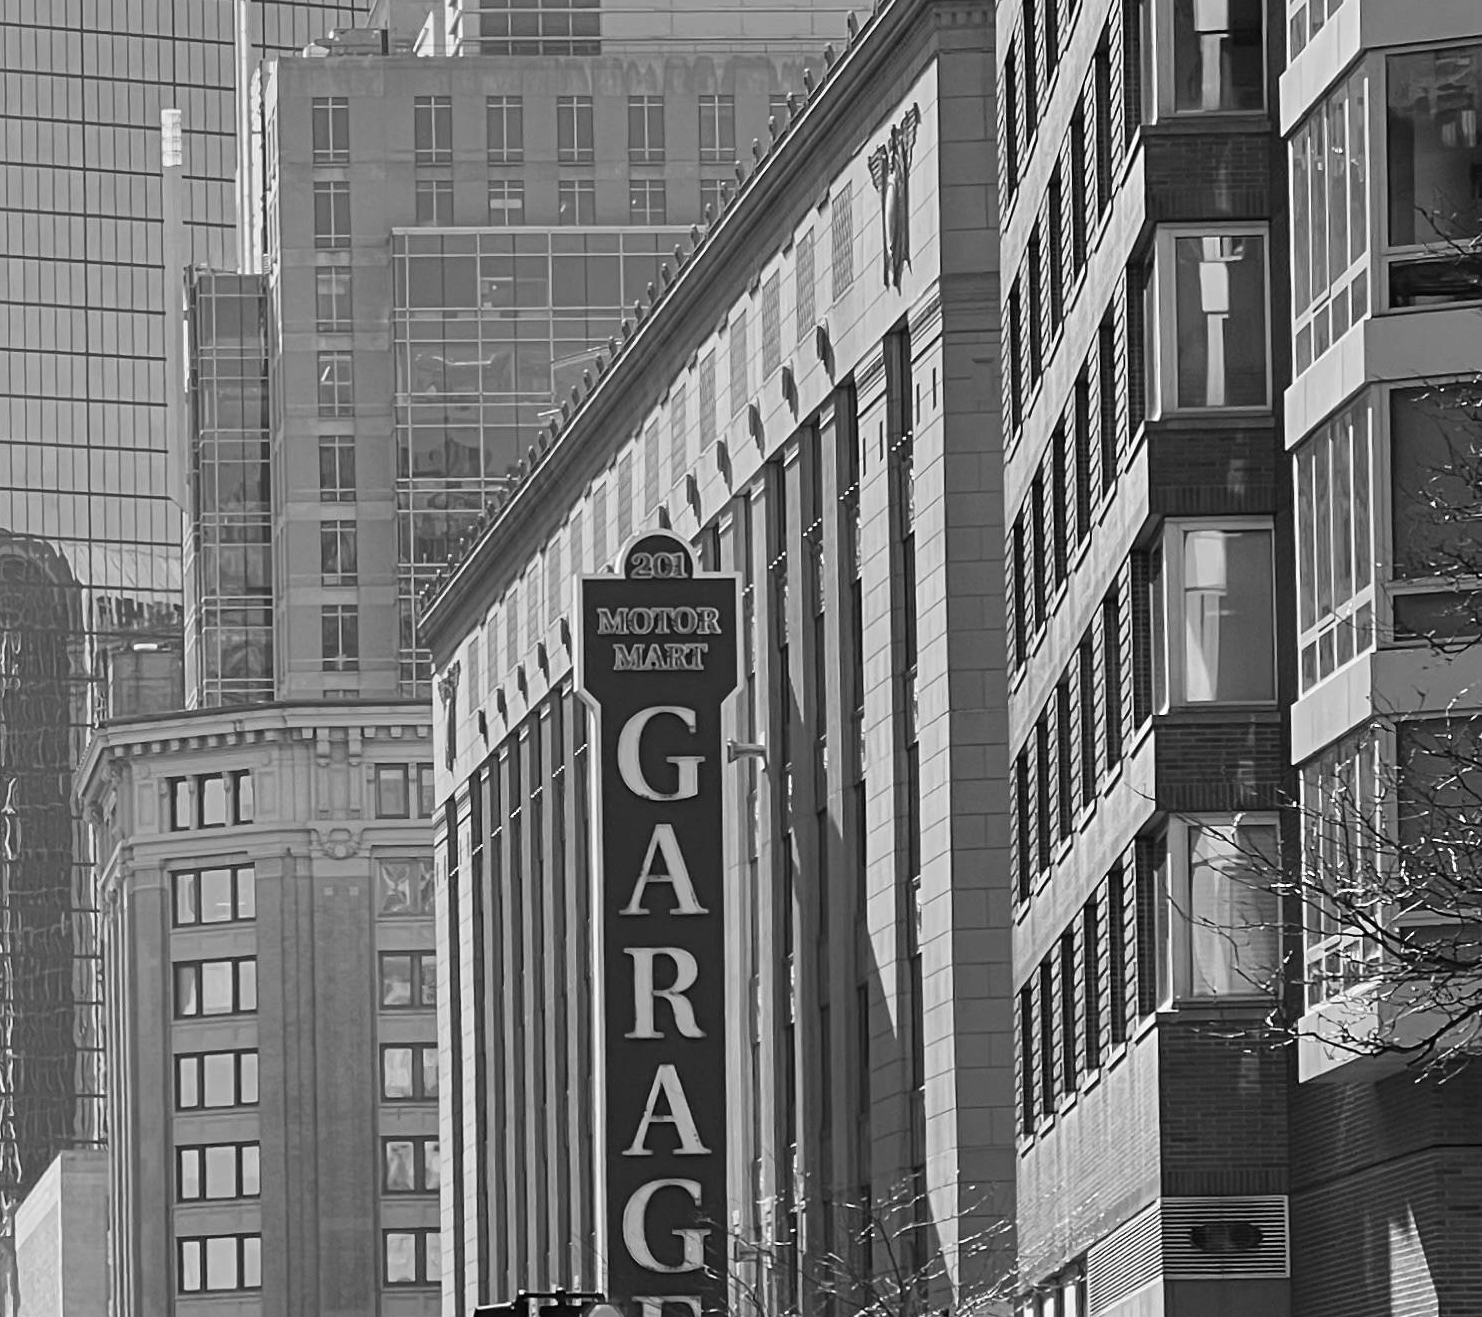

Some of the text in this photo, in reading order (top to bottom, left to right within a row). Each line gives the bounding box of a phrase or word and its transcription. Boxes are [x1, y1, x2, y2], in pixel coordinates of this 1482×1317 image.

[630, 551, 688, 579] 201
[596, 606, 722, 635] MOTOR
[612, 643, 708, 671] MART
